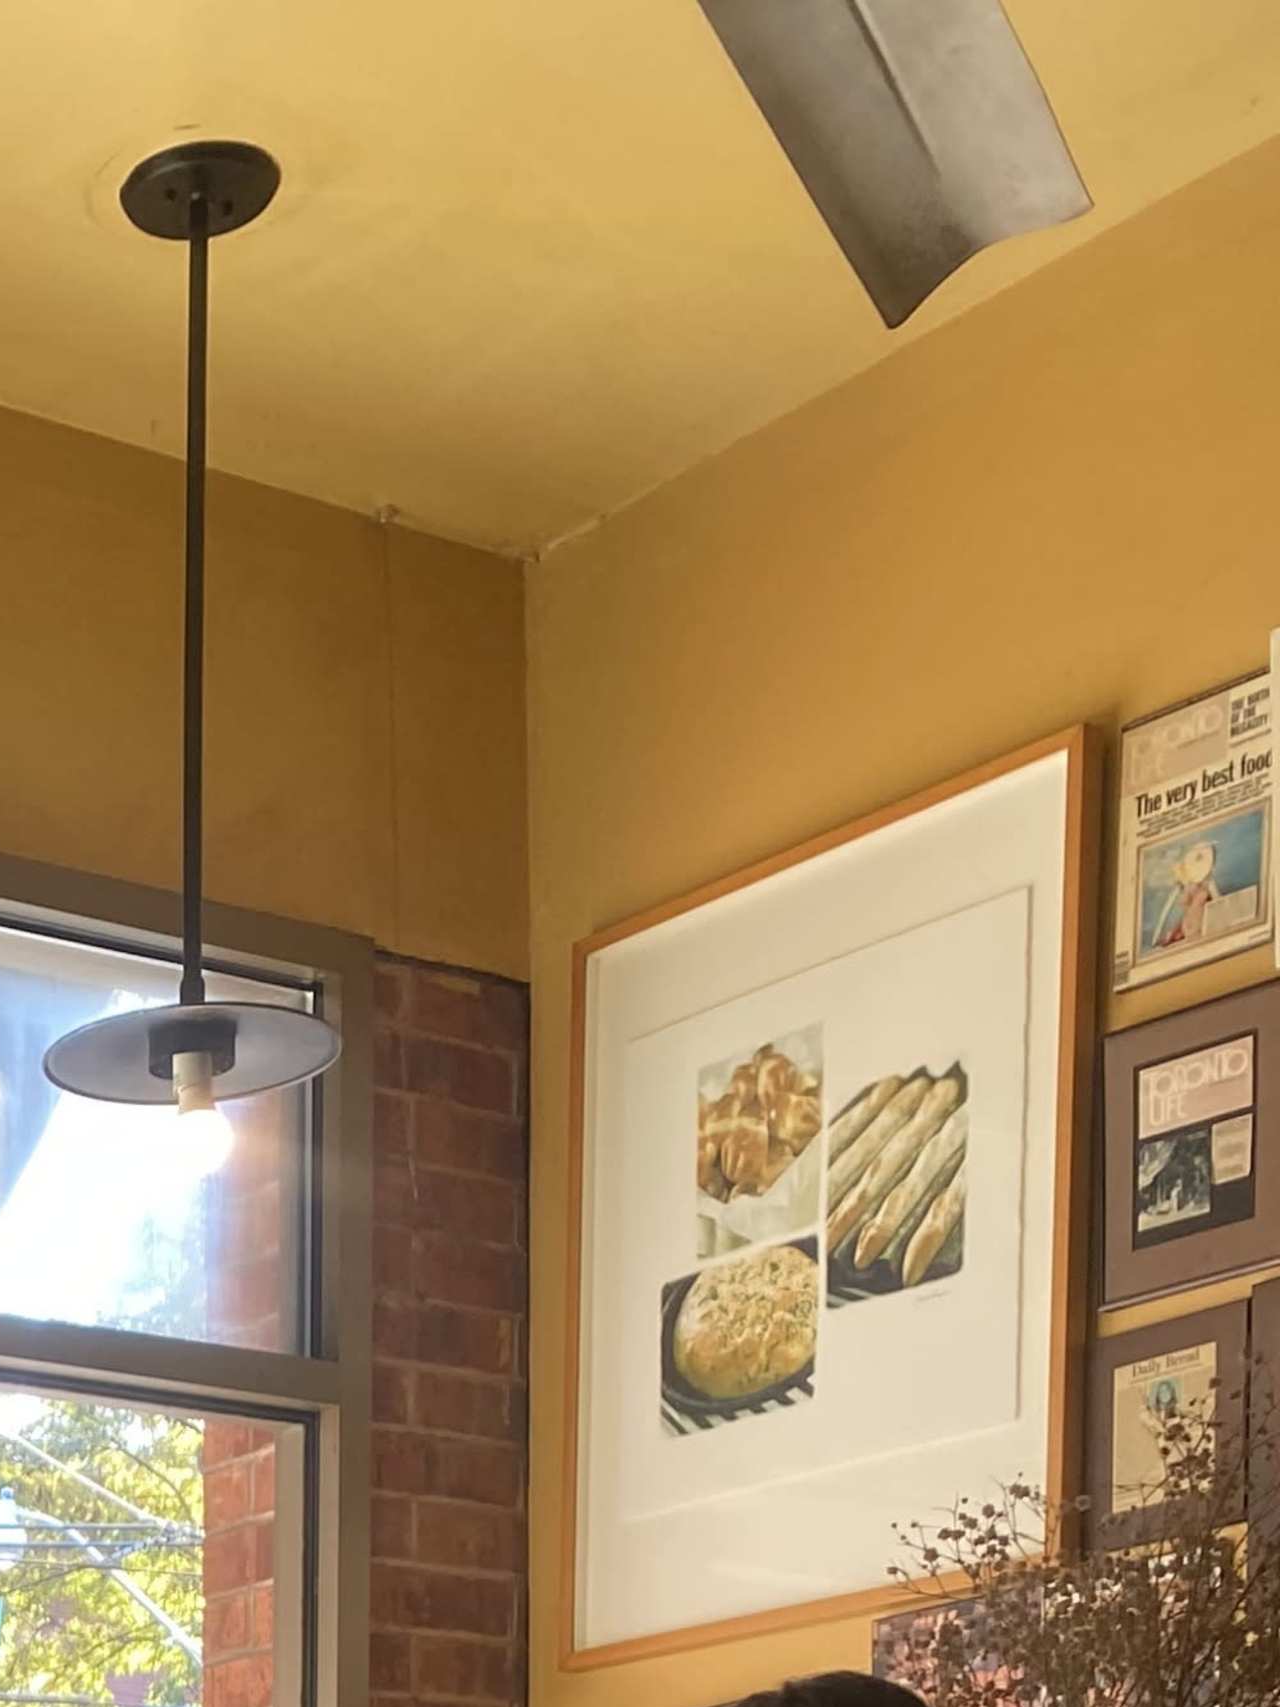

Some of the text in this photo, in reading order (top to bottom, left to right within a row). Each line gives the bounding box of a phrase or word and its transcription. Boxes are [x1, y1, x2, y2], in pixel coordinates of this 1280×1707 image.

[1136, 792, 1162, 818] The
[1166, 780, 1198, 806] very
[1201, 759, 1234, 793] best
[1143, 1049, 1248, 1096] TORONTO
[1132, 1359, 1162, 1378] Daily
